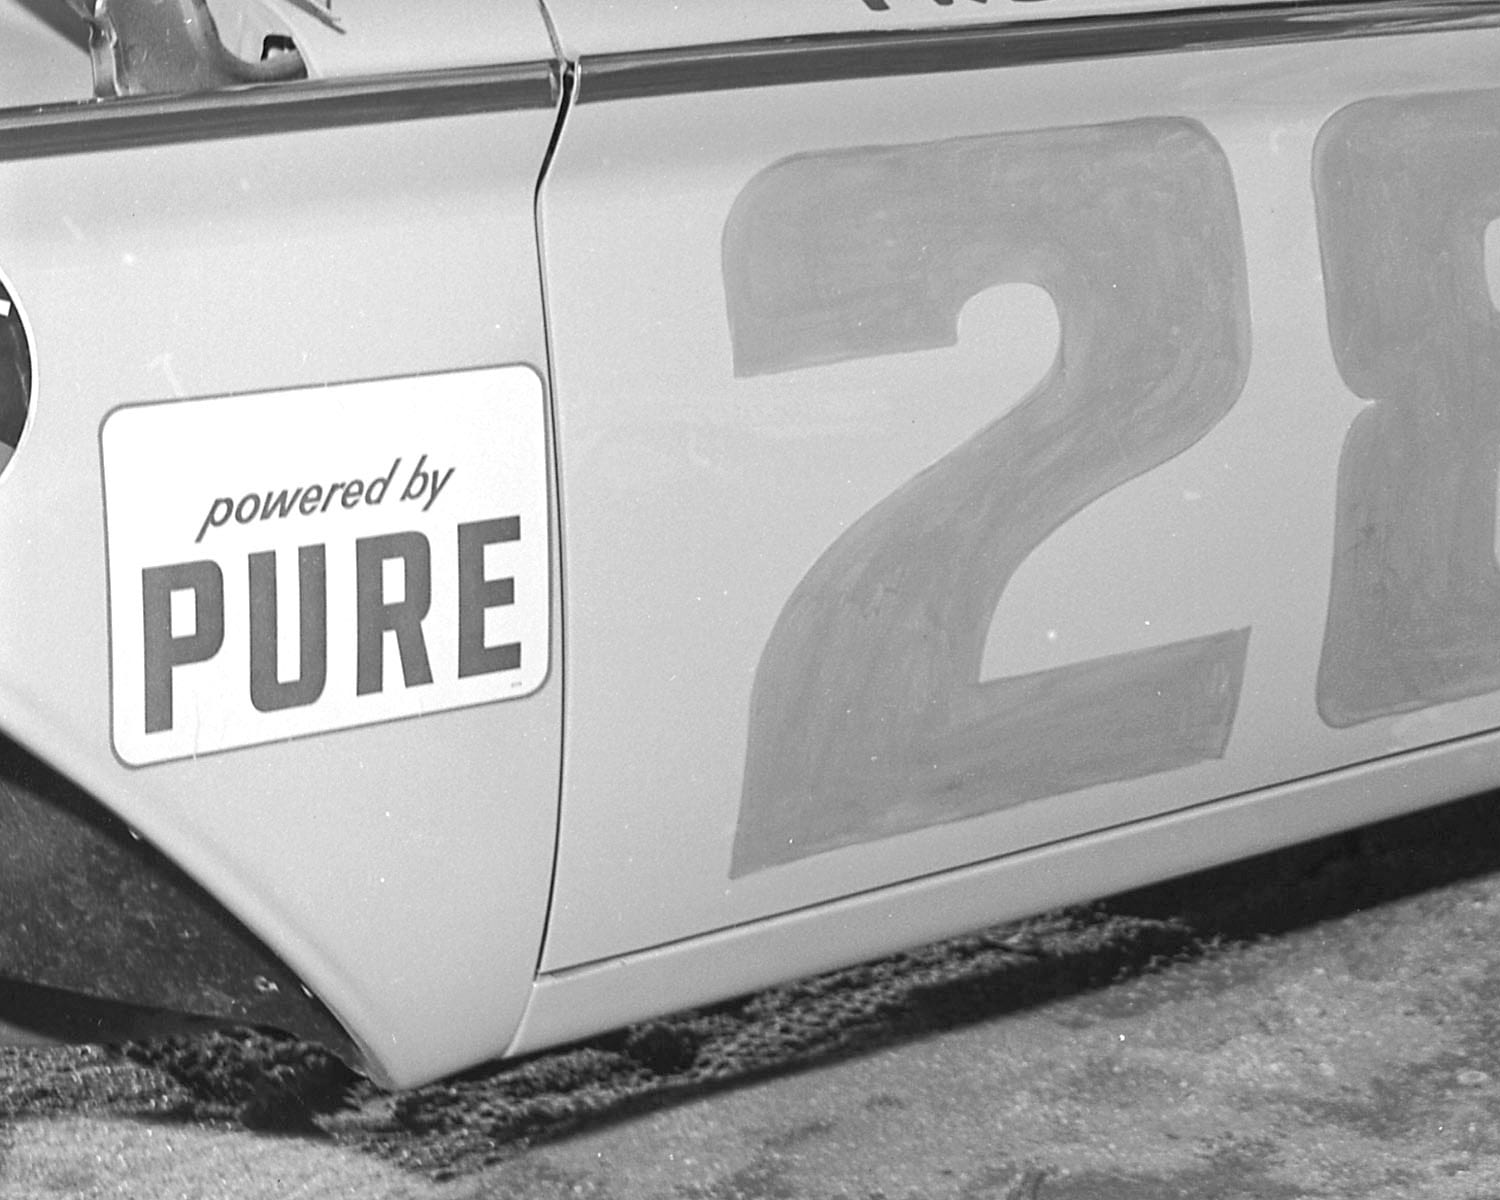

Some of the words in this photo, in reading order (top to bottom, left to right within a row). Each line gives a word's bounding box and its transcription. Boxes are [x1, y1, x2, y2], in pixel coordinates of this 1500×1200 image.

[196, 457, 401, 543] powered
[401, 454, 455, 510] by
[141, 514, 521, 735] PURE
